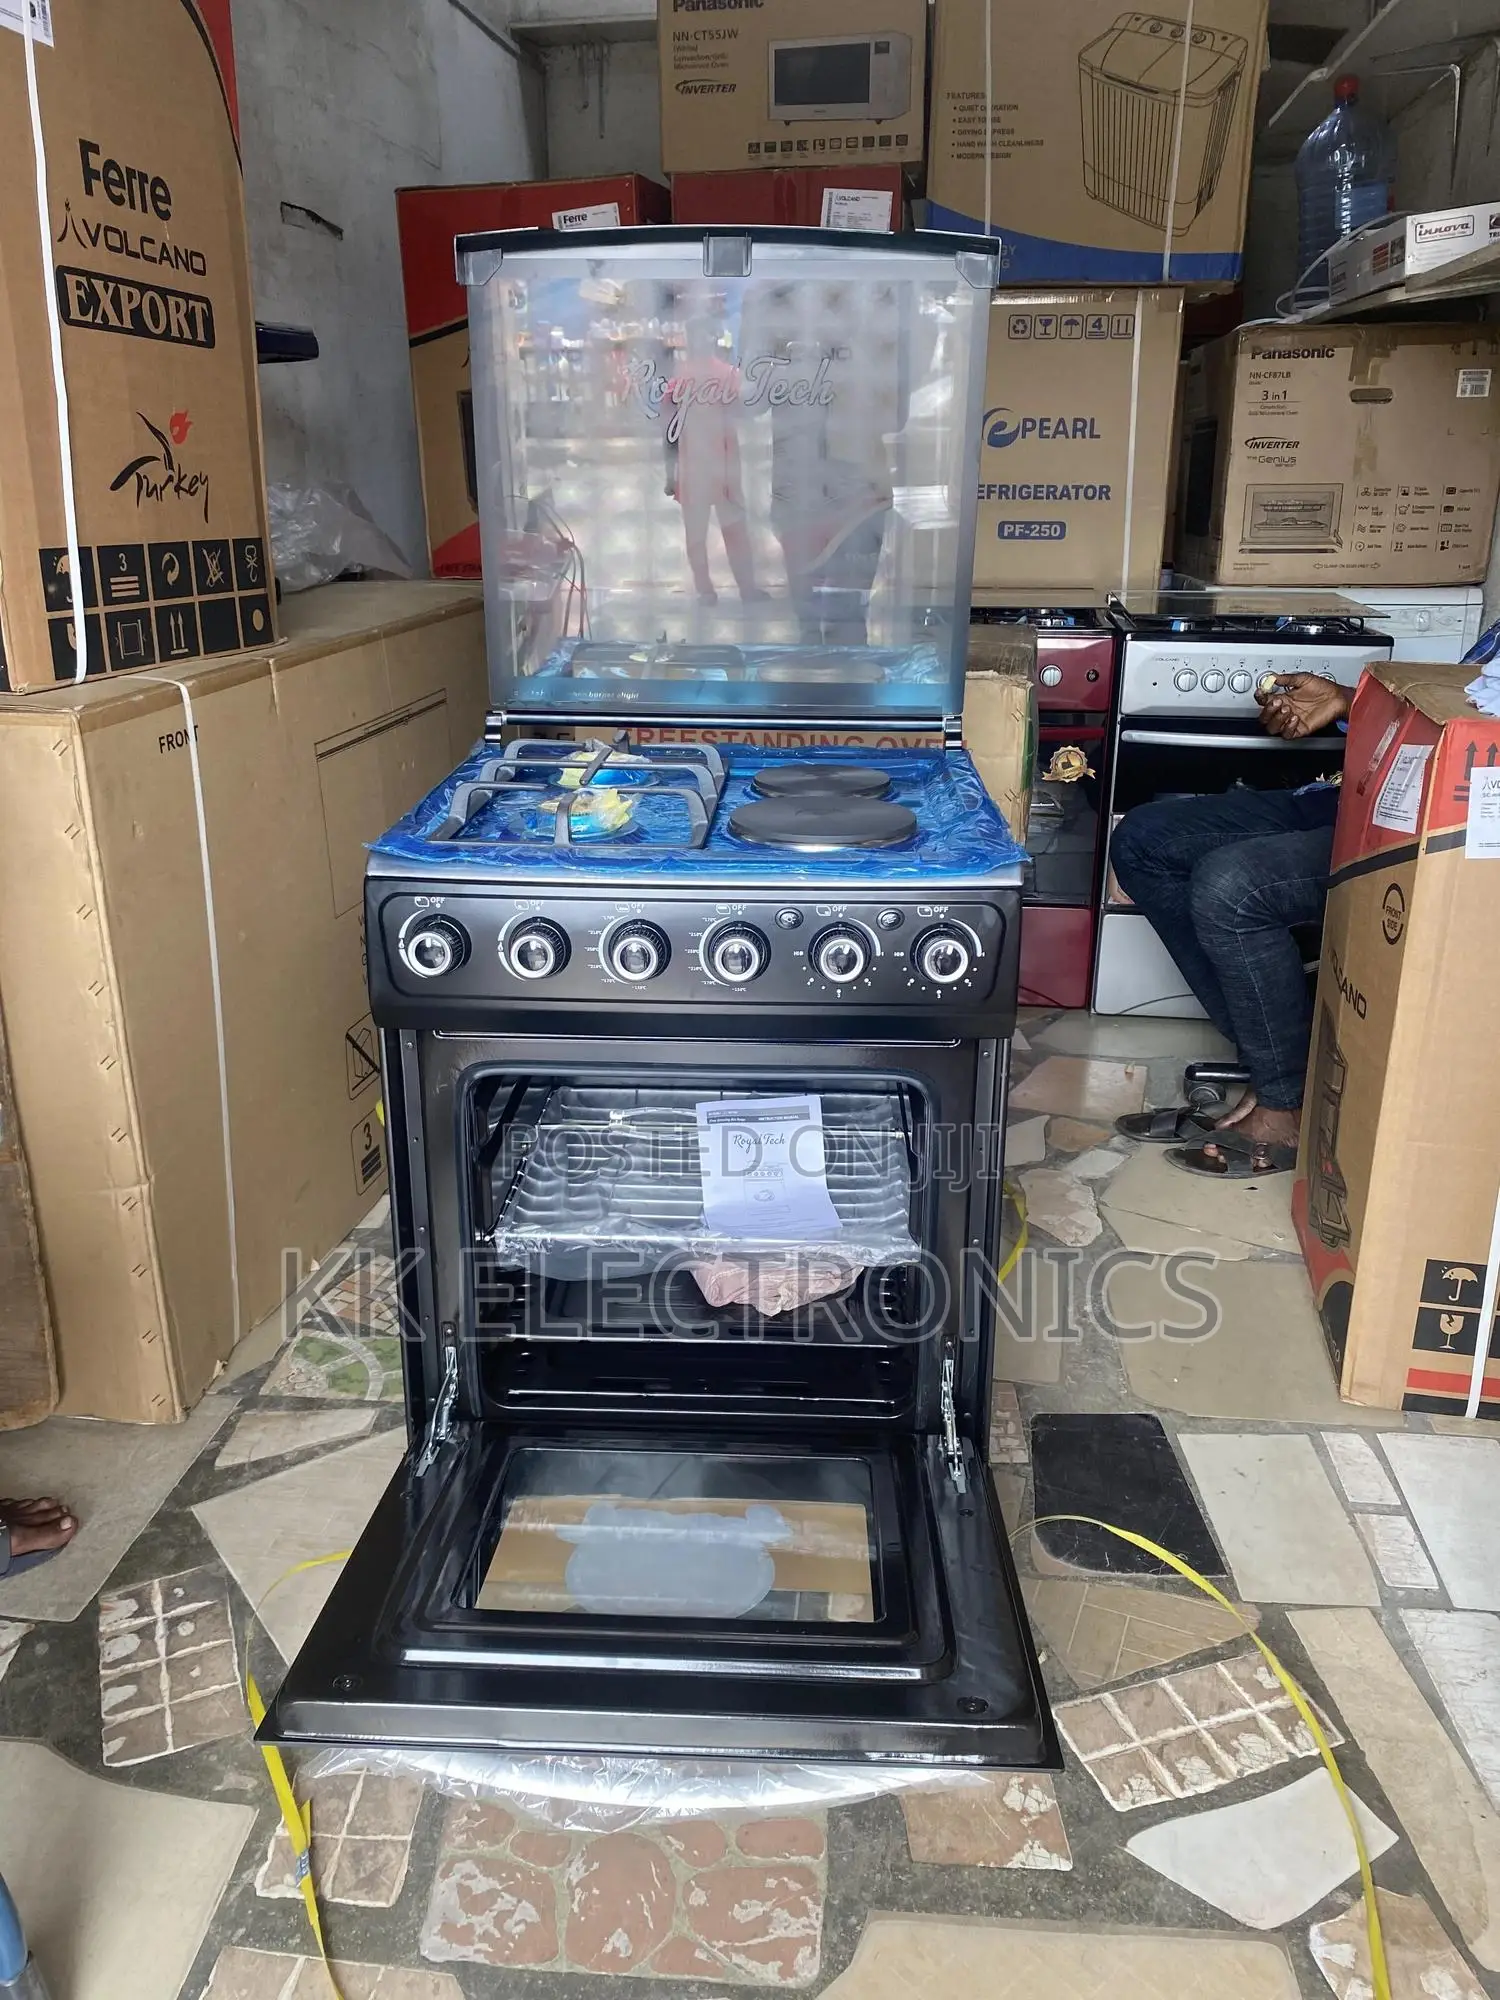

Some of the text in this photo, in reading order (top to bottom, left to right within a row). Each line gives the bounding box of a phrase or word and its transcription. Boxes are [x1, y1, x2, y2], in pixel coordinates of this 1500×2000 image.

[680, 83, 737, 95] INVERTER
[79, 137, 172, 222] Ferre
[563, 213, 588, 224] Ferre
[81, 218, 207, 277] VOLCANO
[63, 272, 210, 343] EXPORT
[1250, 345, 1336, 360] Panasonic
[744, 355, 837, 408] Tech
[1261, 390, 1287, 401] 3 in 1
[1020, 417, 1102, 440] PEARL
[1249, 440, 1301, 450] INVERTER
[977, 484, 1112, 501] EFRIGERATOR
[1003, 524, 1061, 538] PF-250
[118, 552, 128, 572] 3
[876, 736, 968, 749] OVE
[430, 896, 446, 904] OFF
[763, 1132, 786, 1146] Tech
